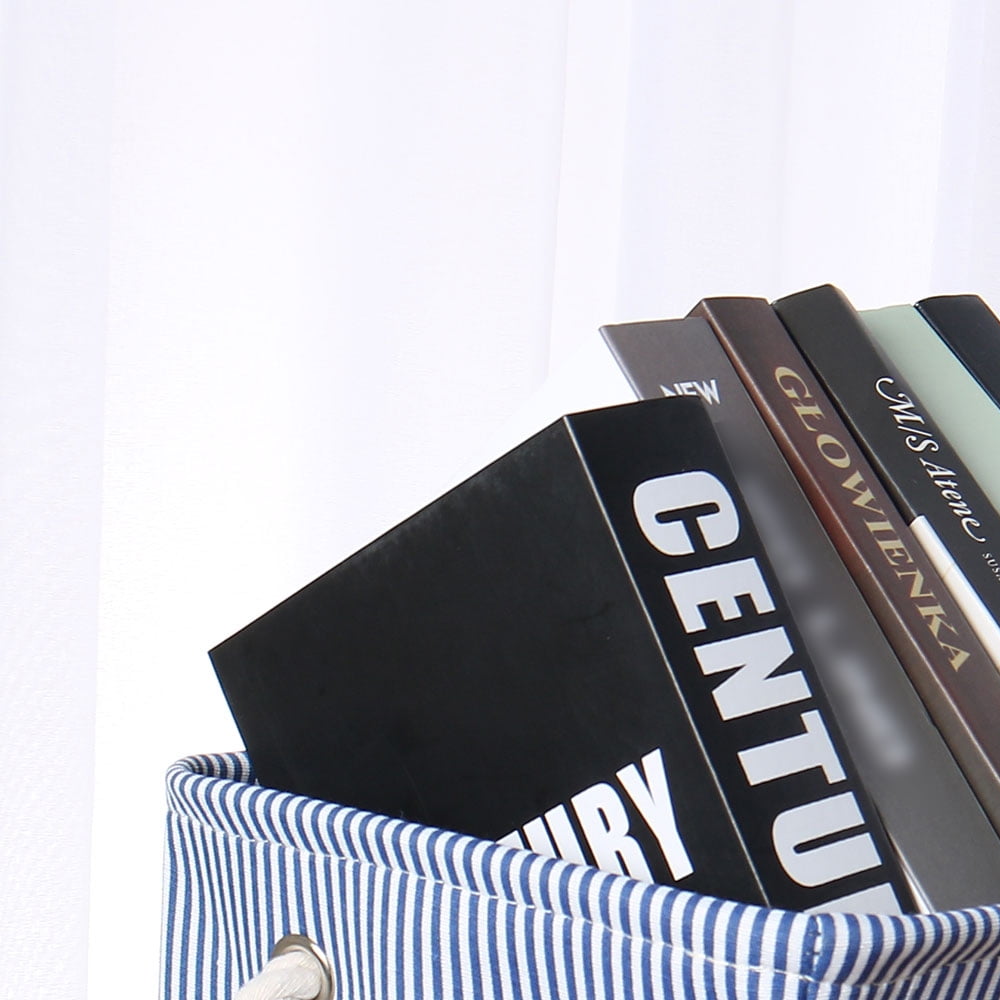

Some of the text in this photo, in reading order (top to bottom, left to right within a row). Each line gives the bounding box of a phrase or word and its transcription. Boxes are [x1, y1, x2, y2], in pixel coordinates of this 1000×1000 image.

[875, 377, 986, 543] M/S Atene
[633, 470, 903, 915] CENTU
